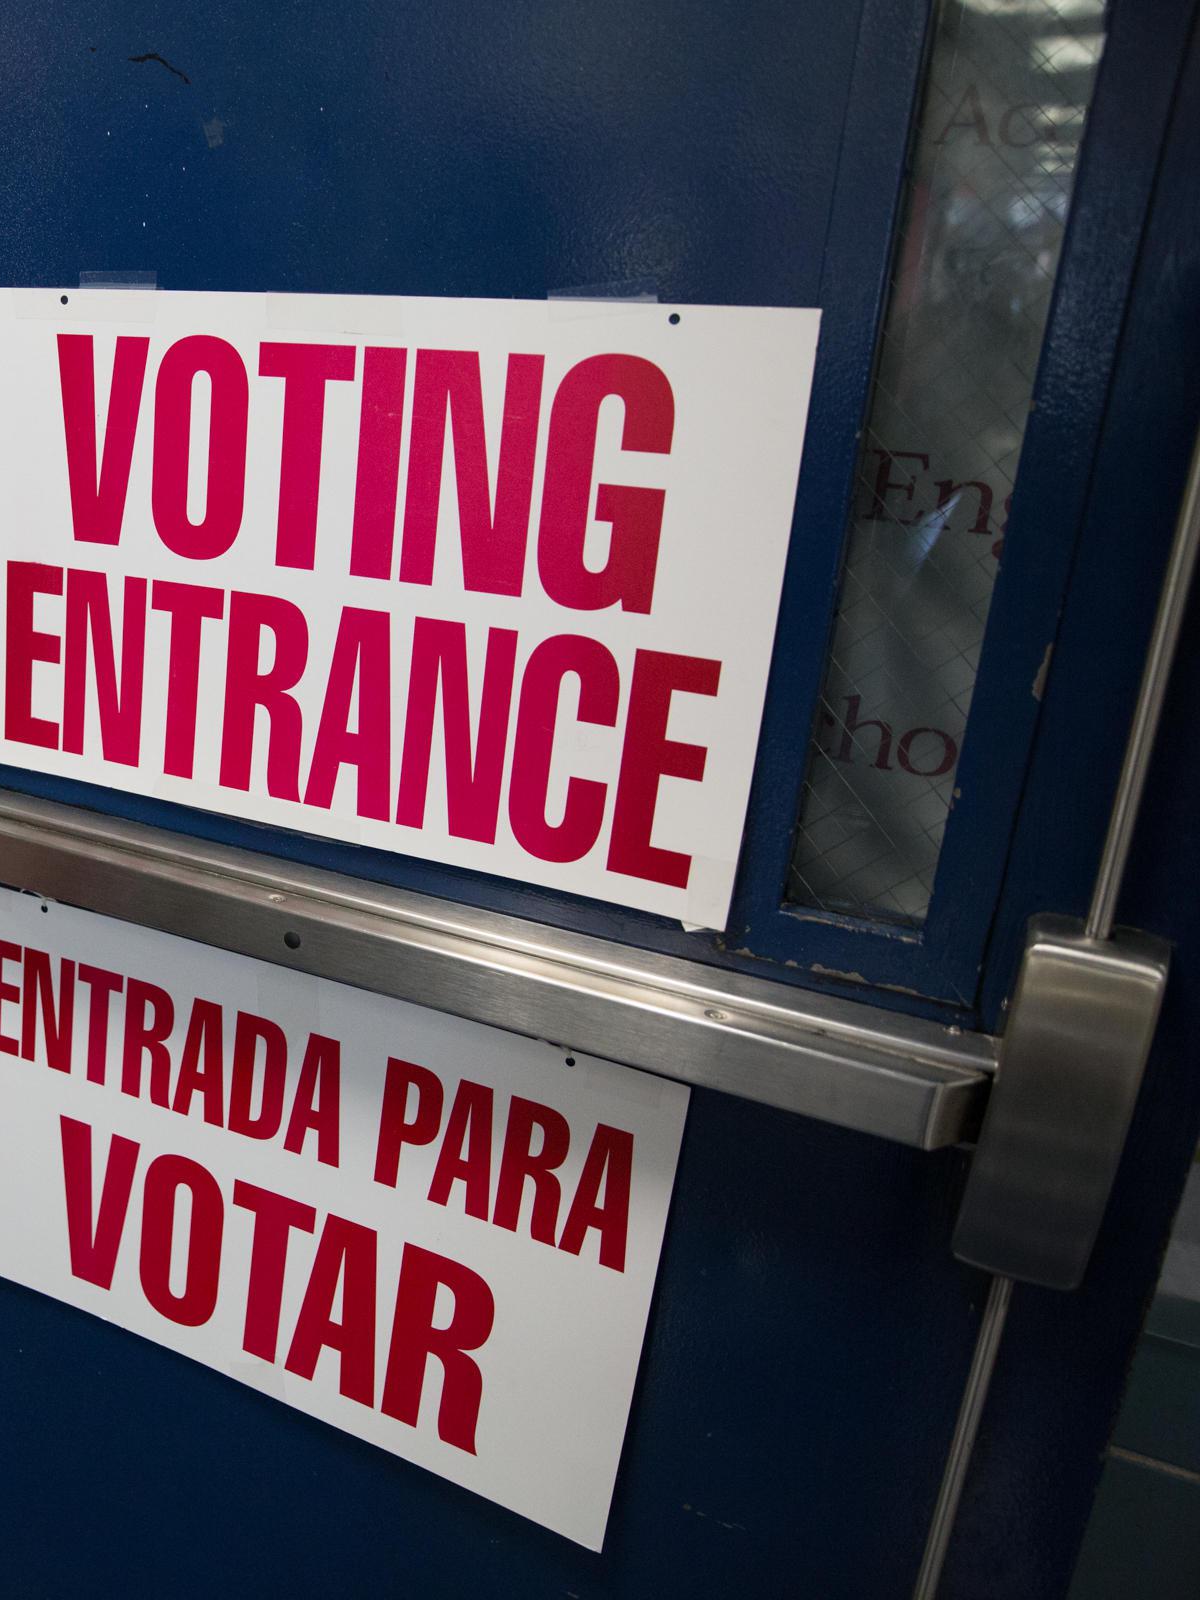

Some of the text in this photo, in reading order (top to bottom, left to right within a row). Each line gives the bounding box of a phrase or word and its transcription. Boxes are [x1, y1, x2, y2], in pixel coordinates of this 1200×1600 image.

[56, 333, 675, 615] VOTING
[862, 449, 1012, 561] En
[3, 559, 721, 889] ENTRANCE
[59, 1115, 495, 1456] VOTAR
[373, 1057, 632, 1273] PARA
